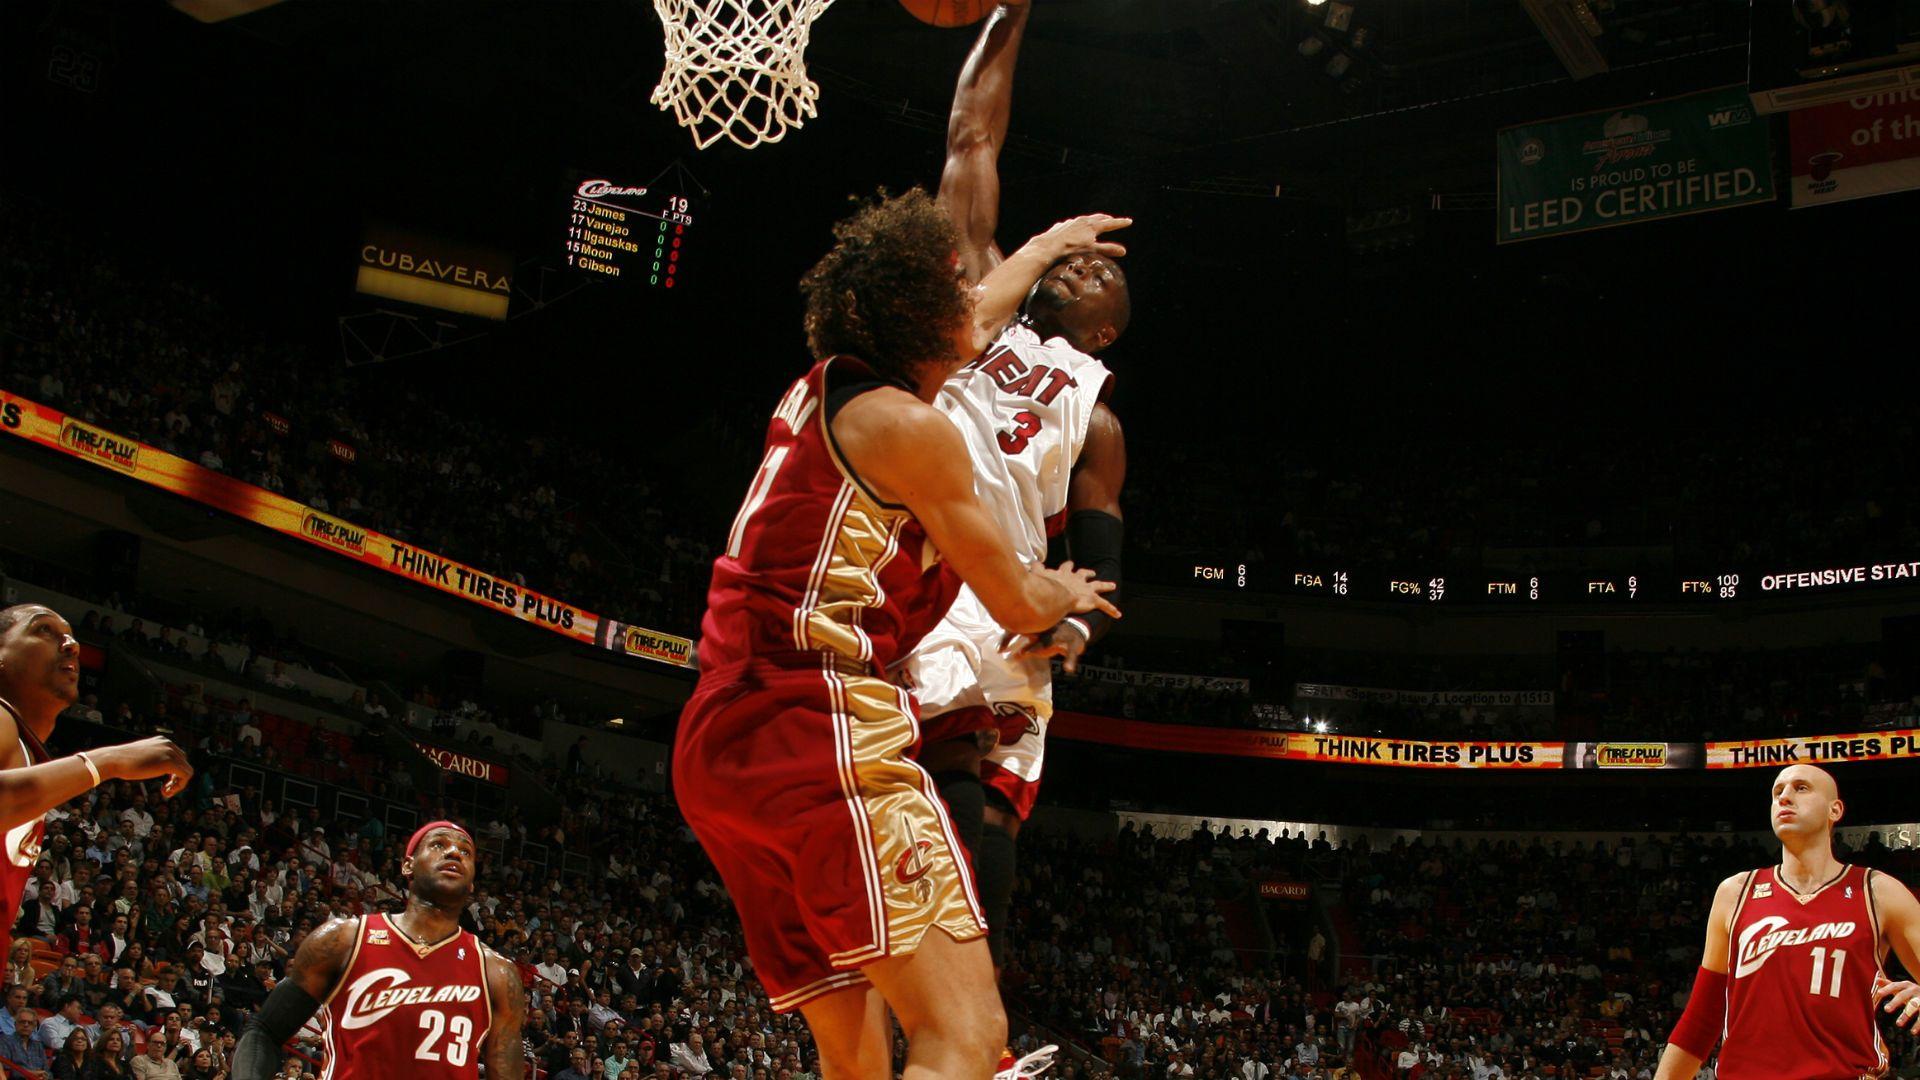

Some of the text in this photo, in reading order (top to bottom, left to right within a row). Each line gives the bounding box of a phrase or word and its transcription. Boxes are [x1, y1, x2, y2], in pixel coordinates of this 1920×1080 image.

[1851, 118, 1884, 146] of
[1570, 159, 1696, 191] IS PROUD TO BE
[577, 179, 648, 198] CLEVELAND
[669, 196, 689, 213] 19
[1509, 168, 1764, 233] LEED CERTIFIED.
[573, 200, 626, 222] 23 James
[662, 210, 693, 225] F PTS
[571, 214, 585, 225] 17
[586, 217, 629, 237] Varejao
[660, 221, 667, 232] 0
[568, 227, 582, 239] 11
[583, 230, 639, 253] Ilgauskas
[657, 234, 665, 245] 0
[566, 241, 580, 252] 15
[581, 243, 613, 260] Moon
[655, 248, 662, 259] 0
[362, 245, 511, 292] CUBAVERA
[567, 255, 574, 266] 1
[578, 257, 620, 277] Gibson
[652, 261, 660, 272] 0
[650, 274, 657, 285] 0
[71, 424, 136, 459] TIRES PLUS
[996, 412, 1042, 455] 3
[311, 516, 366, 545] TIRES PLUS
[1194, 564, 1246, 580] FGM 6
[1237, 575, 1246, 588] 6
[1295, 571, 1348, 587] FGA 14
[1761, 562, 1920, 591] OFFENSIVE STAT
[391, 543, 575, 630] THINK TIRES PLUS
[1333, 583, 1348, 595] 16
[1390, 578, 1444, 594] FG% 42
[1488, 577, 1538, 594] FTM 6
[1588, 576, 1637, 593] FTA 6
[1629, 587, 1637, 599] 7
[1682, 574, 1739, 593] FT% 100
[1720, 587, 1736, 598] 85
[1429, 589, 1444, 601] 37
[1530, 588, 1538, 600] 6
[634, 633, 688, 655] TIRES PLUS
[1444, 692, 1495, 705] Location
[1499, 693, 1511, 703] to
[1314, 738, 1534, 763] THINK TIRES PLUS
[1605, 748, 1663, 758] TIRES PLUS
[1729, 735, 1920, 764] THINK TIRES PL
[1260, 884, 1307, 896] BACARDI
[1735, 915, 1856, 979] CLEVELAND
[1809, 946, 1847, 998] 11
[340, 967, 481, 1029] CLEVELAND
[415, 1009, 473, 1067] 23
